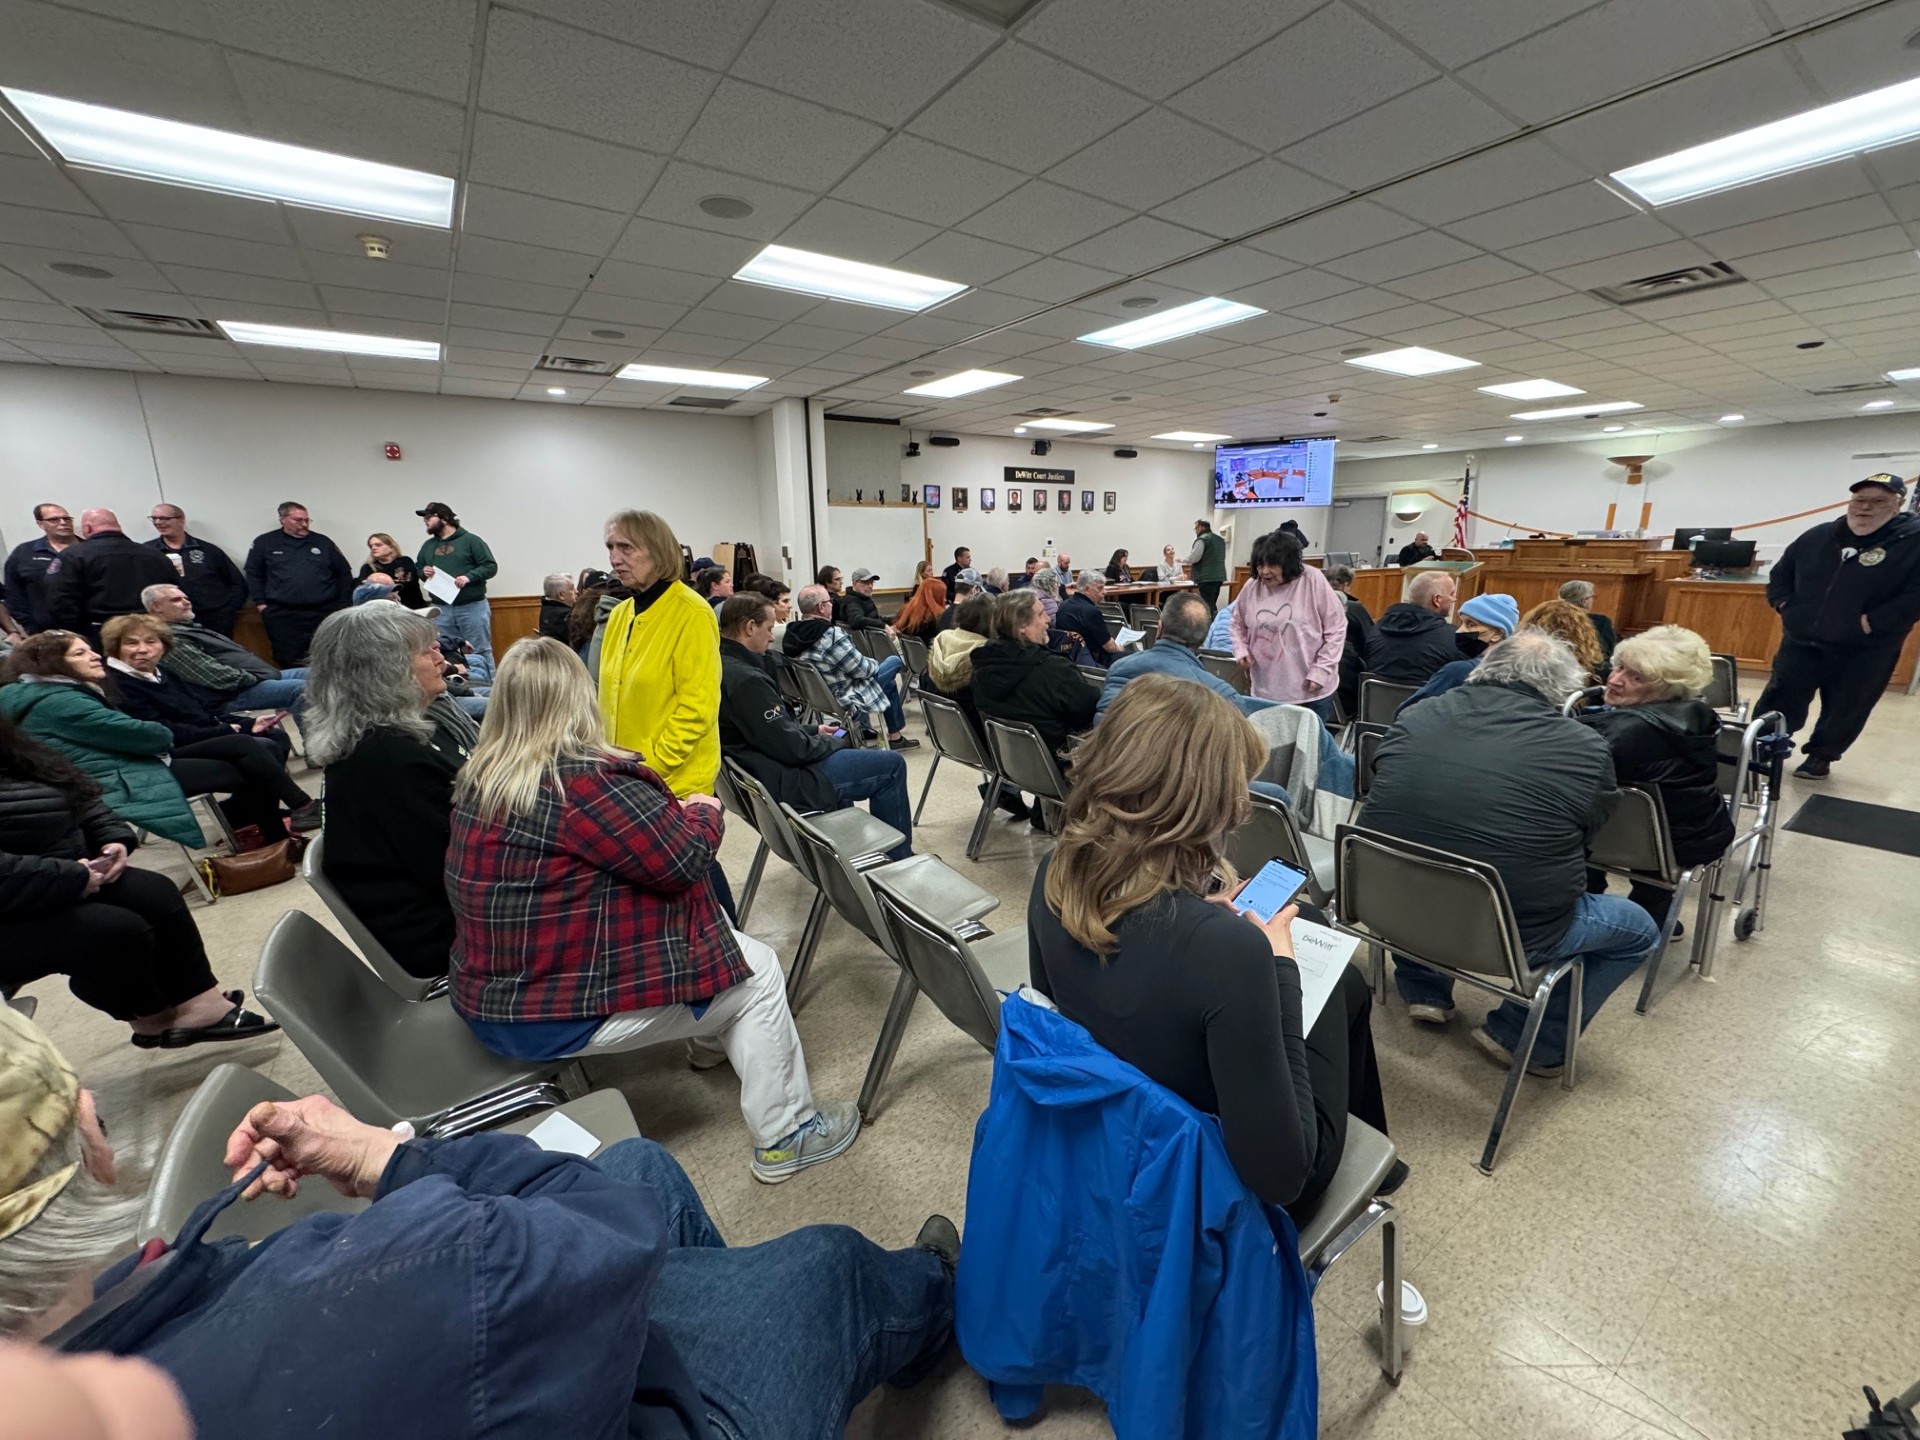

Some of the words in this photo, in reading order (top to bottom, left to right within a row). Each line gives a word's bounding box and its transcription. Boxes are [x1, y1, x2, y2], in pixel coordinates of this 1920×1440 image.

[1015, 470, 1032, 479] DeWitt
[1033, 471, 1046, 480] Court
[1047, 472, 1066, 481] Justices
